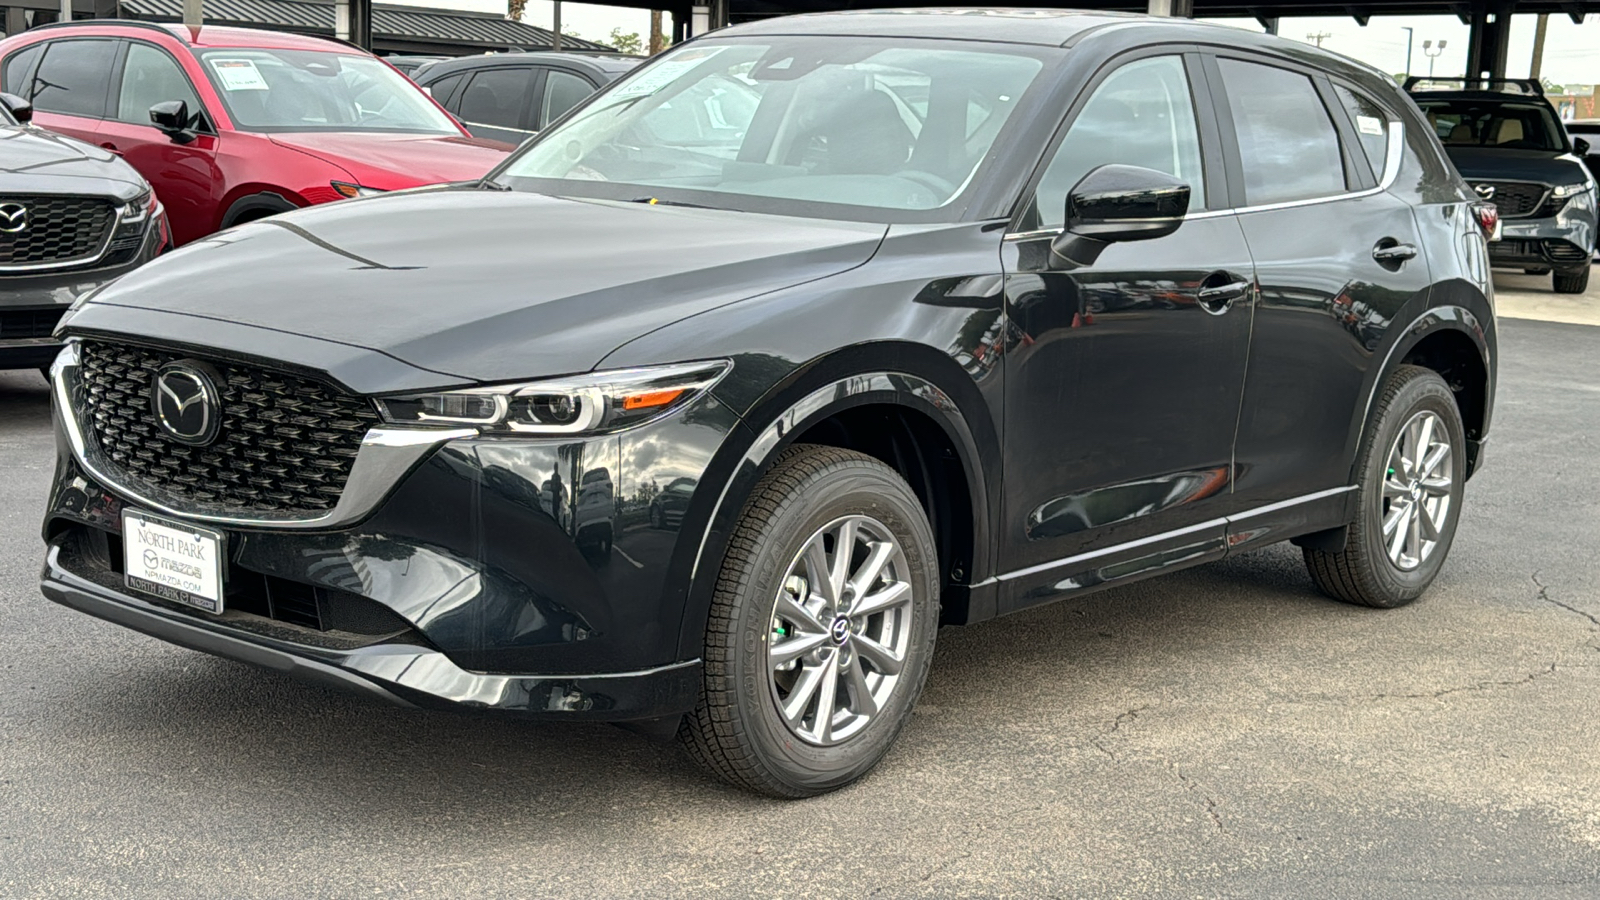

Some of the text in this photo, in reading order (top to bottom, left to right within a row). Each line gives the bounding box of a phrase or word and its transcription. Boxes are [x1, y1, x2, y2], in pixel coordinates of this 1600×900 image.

[137, 528, 206, 561] NORTH PARK
[129, 577, 156, 591] NORTH
[158, 585, 179, 600] PARK
[145, 569, 202, 593] NPMAZDA.COM
[743, 541, 785, 716] YOKOHAMA
